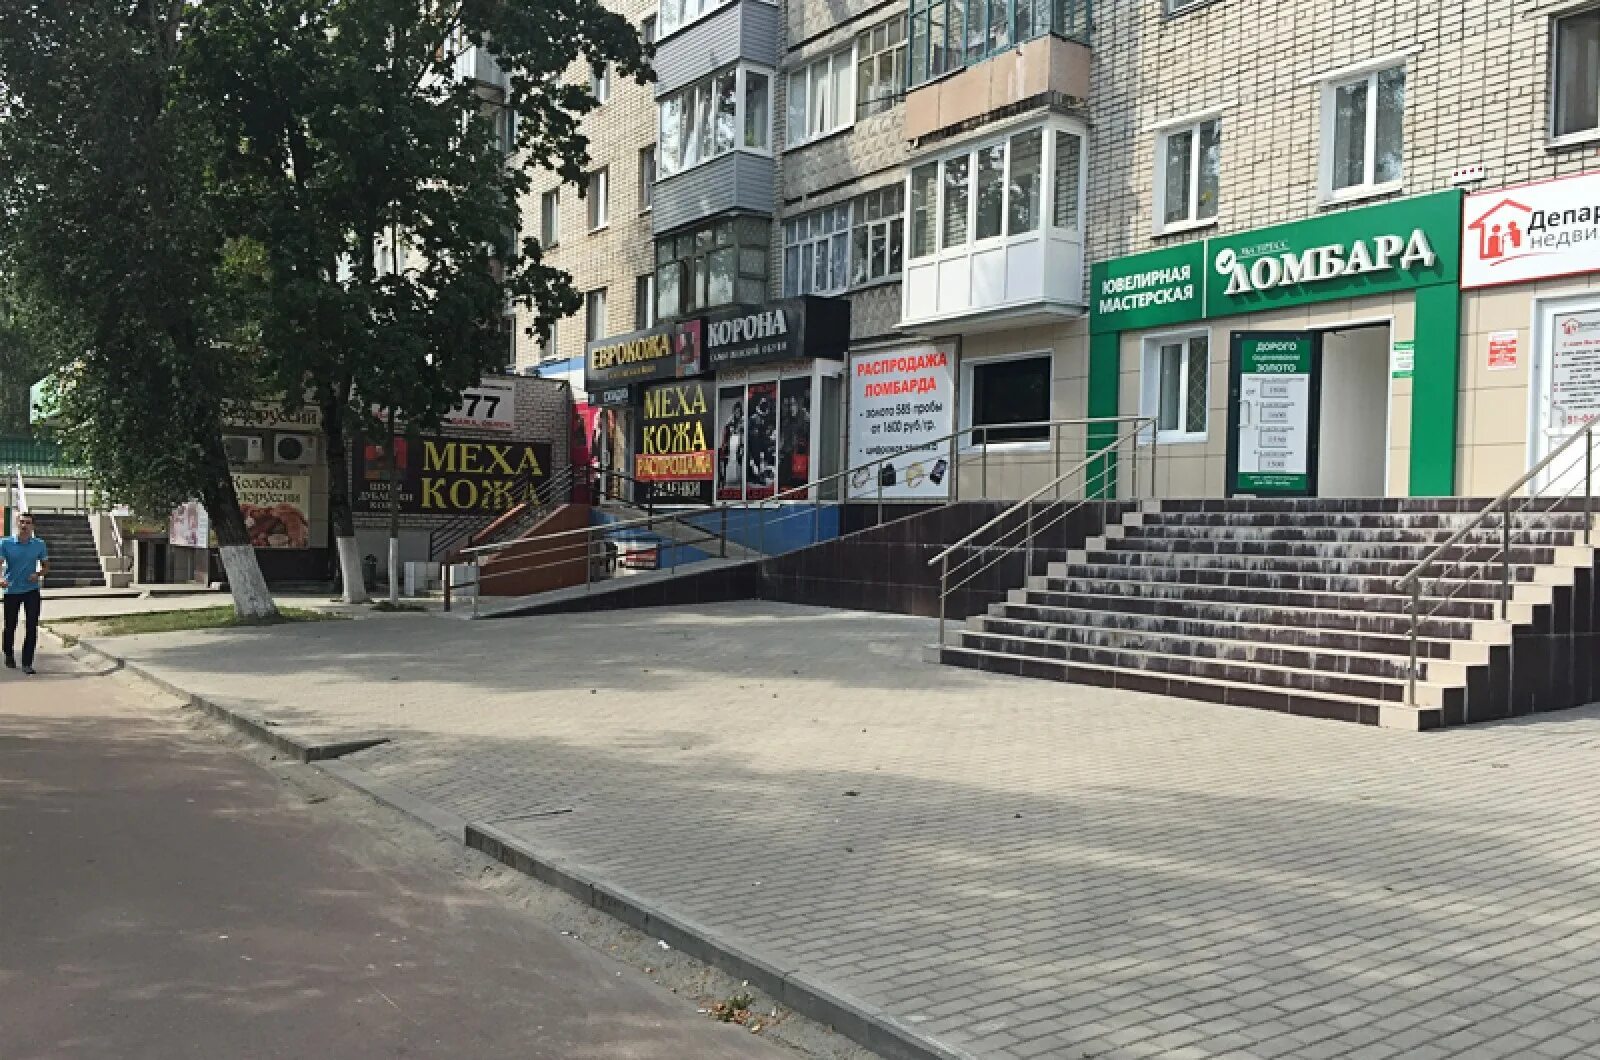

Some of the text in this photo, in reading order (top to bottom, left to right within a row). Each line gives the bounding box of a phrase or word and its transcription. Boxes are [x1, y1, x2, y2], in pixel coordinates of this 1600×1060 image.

[1223, 228, 1435, 295] ЛОМБАРД
[1102, 264, 1191, 294] ЮВЕЛИРНАЯ
[1099, 284, 1193, 315] МАСТЕРСКАЯ
[708, 309, 787, 347] КОРОНА
[592, 333, 671, 370] ЕВРОКОЖА
[1256, 341, 1297, 352] ДОРОГО
[857, 352, 948, 376] РАСПРОДАЖА
[1256, 363, 1297, 373] ЗОЛОТО
[643, 383, 708, 419] МЕХА
[864, 376, 937, 398] ЛОМБАРДА
[895, 401, 911, 415] 585
[913, 399, 943, 415] пробы
[643, 420, 707, 454] КОЖА
[869, 423, 881, 434] от
[883, 419, 903, 433] 1600
[422, 441, 543, 476] МЕХА
[637, 454, 712, 477] РАСПРОДАЖА
[420, 477, 541, 510] КОЖА
